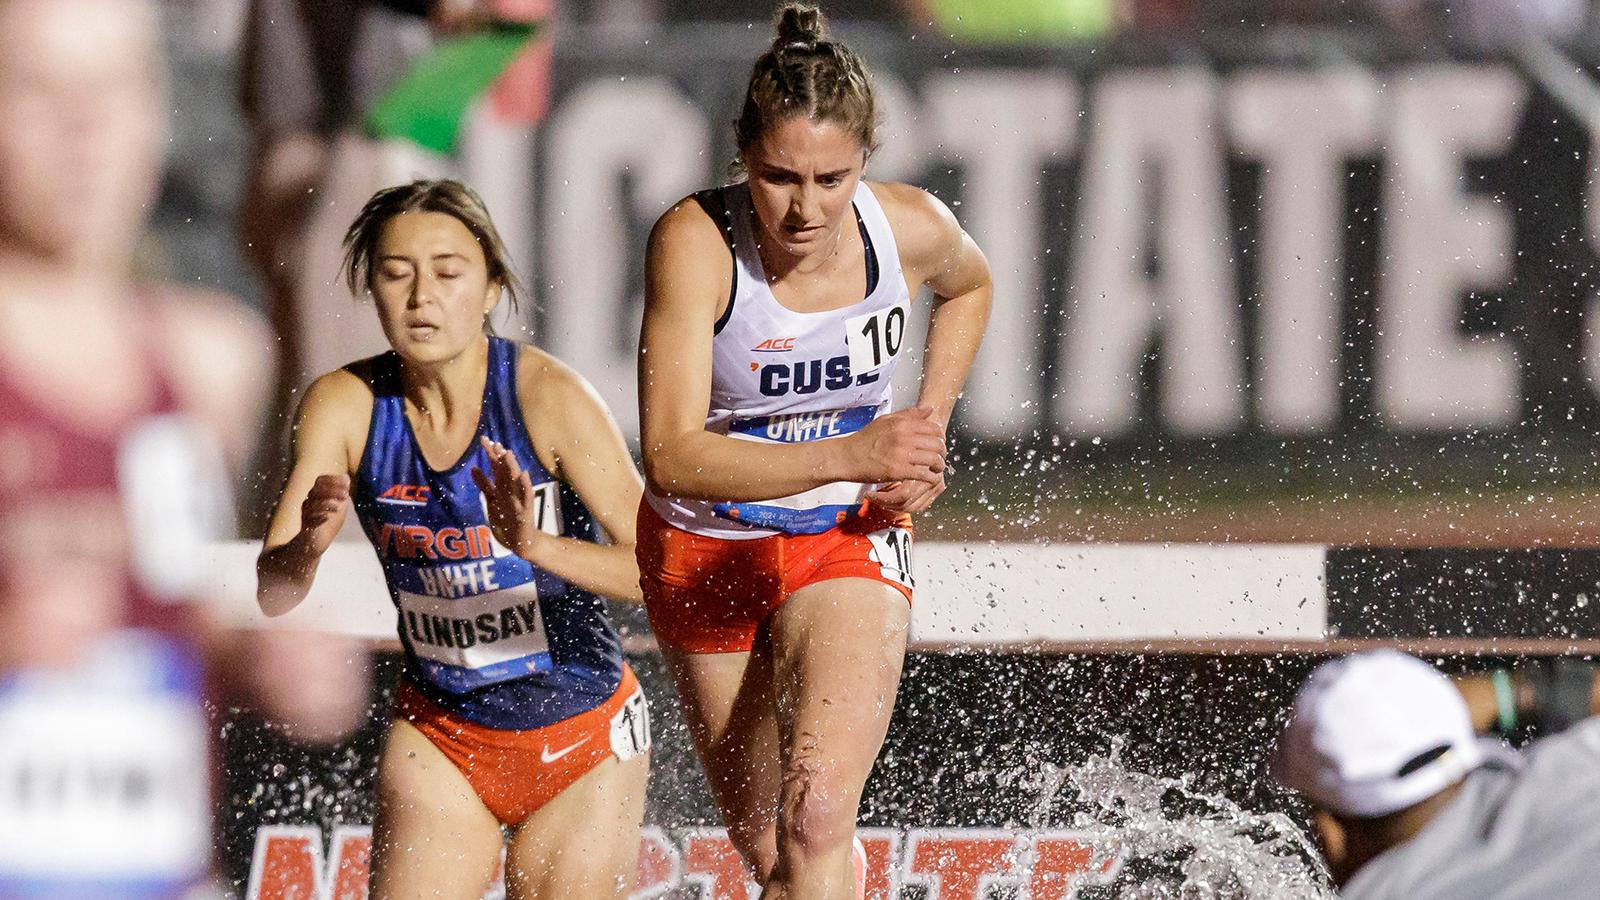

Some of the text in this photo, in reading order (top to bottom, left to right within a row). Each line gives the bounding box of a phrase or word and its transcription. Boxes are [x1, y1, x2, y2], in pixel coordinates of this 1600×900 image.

[755, 337, 798, 350] ACC
[861, 306, 905, 367] 10
[766, 409, 847, 442] UNITE
[383, 484, 430, 502] ACC
[418, 558, 500, 599] UNITE
[885, 530, 915, 588] 10
[406, 600, 536, 649] LINDSAY
